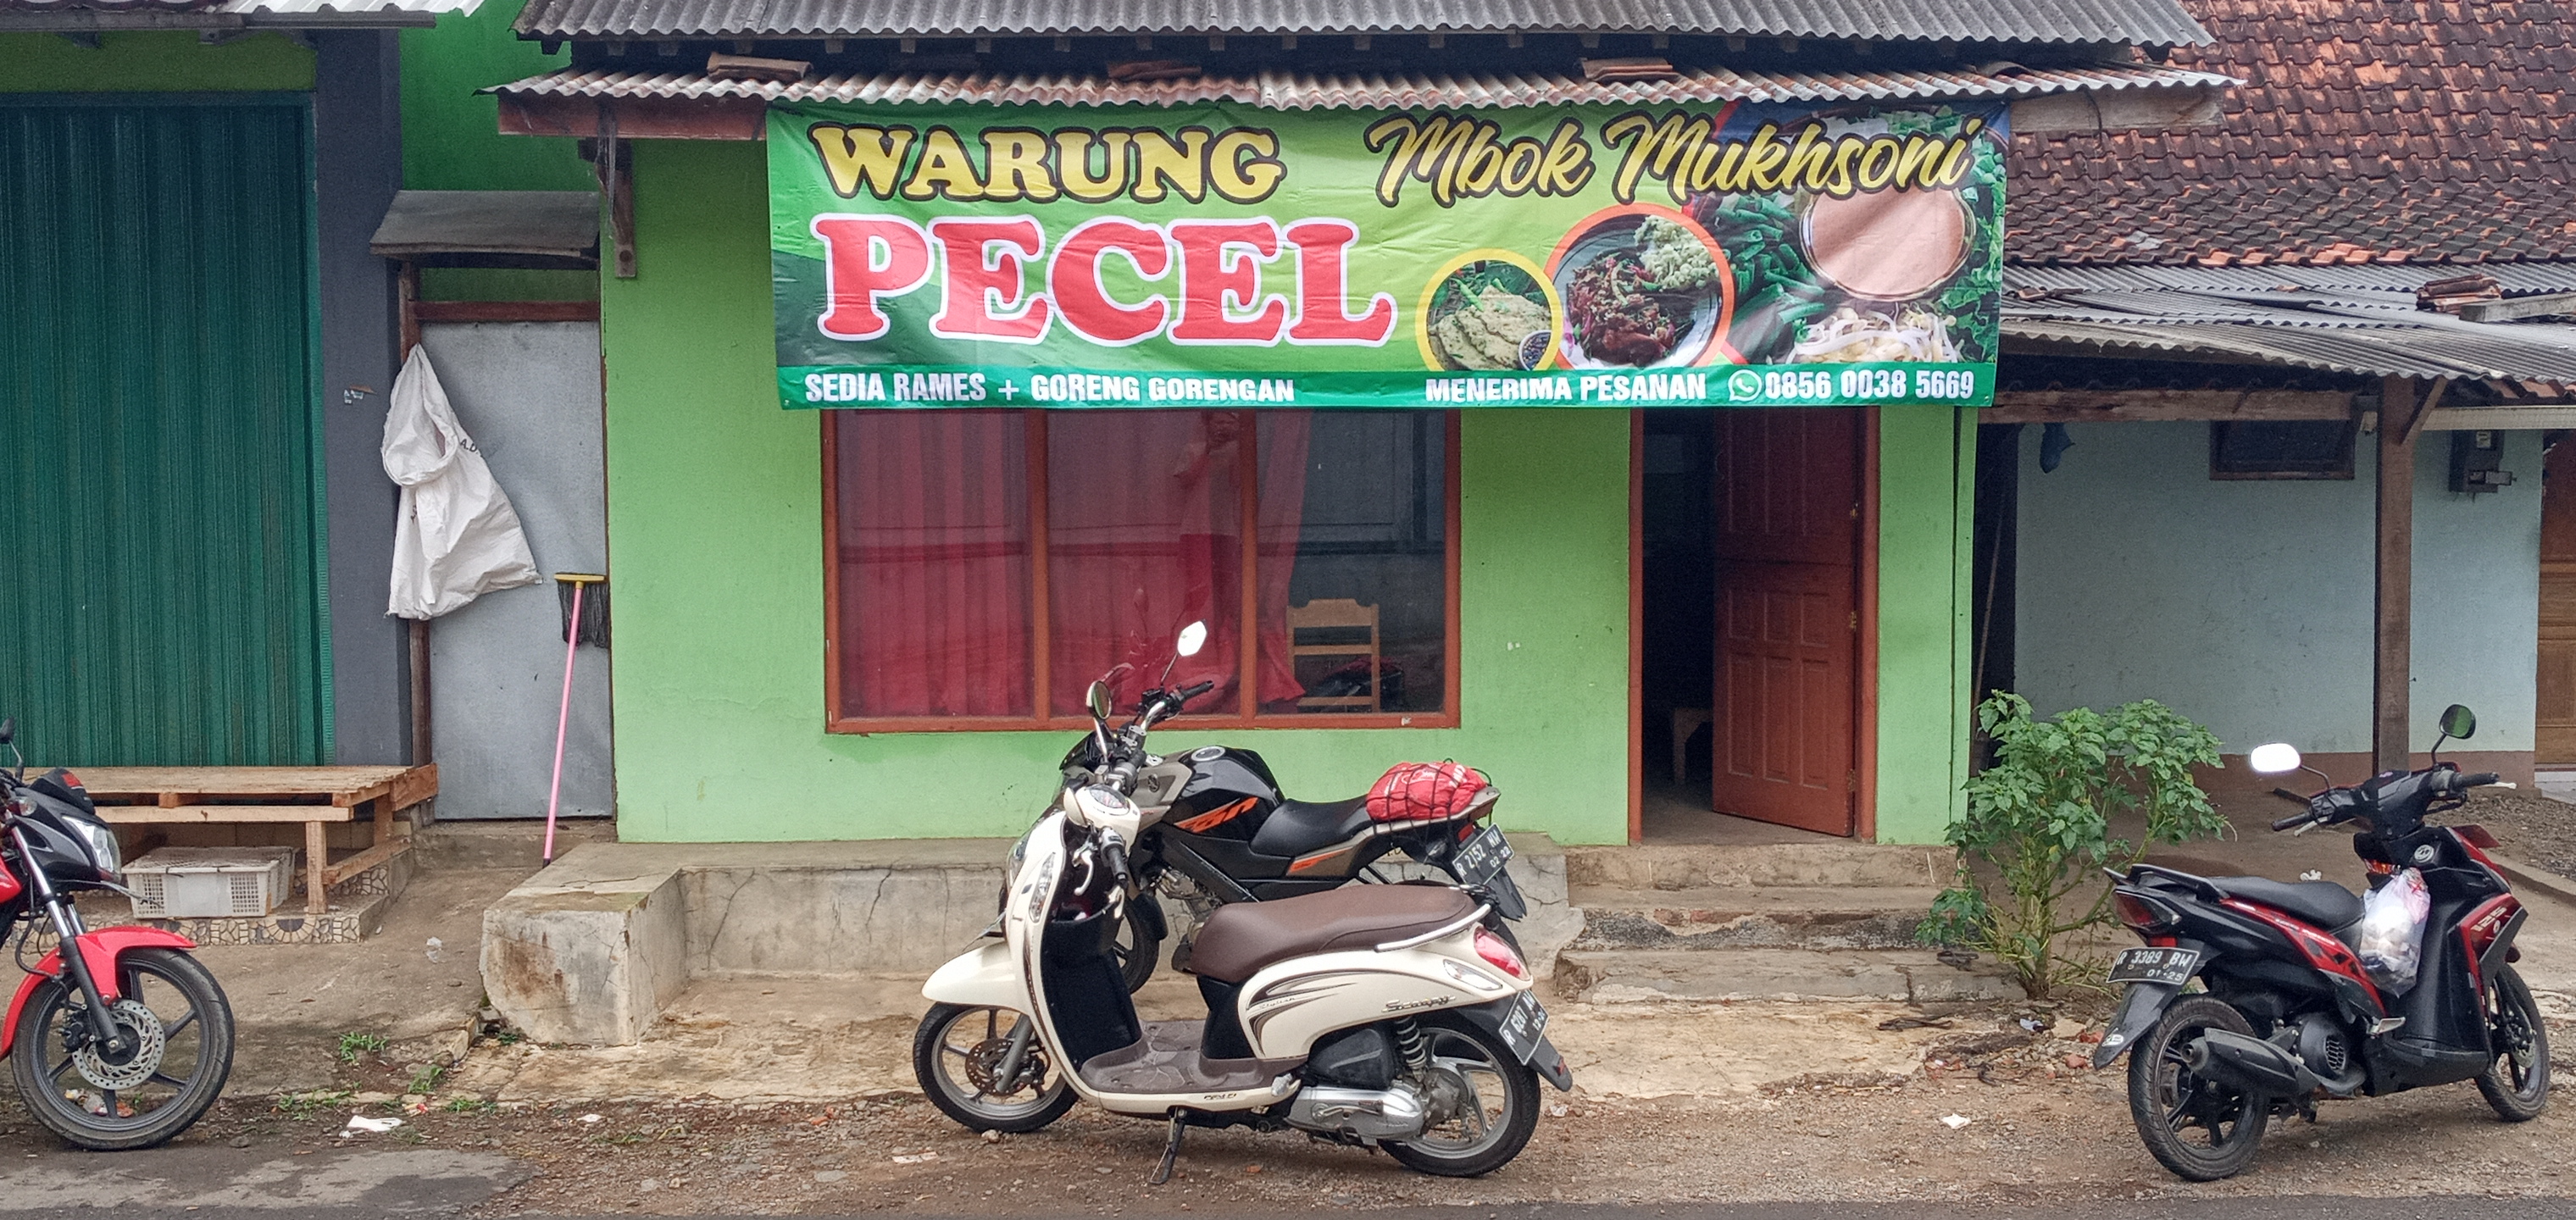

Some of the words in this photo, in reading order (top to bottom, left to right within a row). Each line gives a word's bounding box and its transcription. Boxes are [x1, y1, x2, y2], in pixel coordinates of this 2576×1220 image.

[809, 123, 1286, 204] WARUNG
[1363, 109, 1596, 208] Mbok
[1599, 109, 1987, 205] Mukhsoni
[810, 214, 1397, 346] PECEL
[805, 373, 886, 402] SEDIA
[894, 372, 986, 402] RAMES
[998, 379, 1019, 401] +
[1030, 373, 1141, 402] GORENG
[1148, 377, 1295, 402] GORENGAN
[1425, 376, 1573, 402] MENERIMA
[1580, 373, 1707, 402] PESANAN
[1765, 371, 1832, 399] 0856
[1840, 369, 1907, 398] 0038
[1915, 369, 1974, 399] 5669
[2469, 906, 2507, 932] 125
[2117, 951, 2129, 966] R
[2131, 951, 2163, 964] 3389
[2169, 951, 2193, 967] BW
[1502, 1029, 1516, 1045] R
